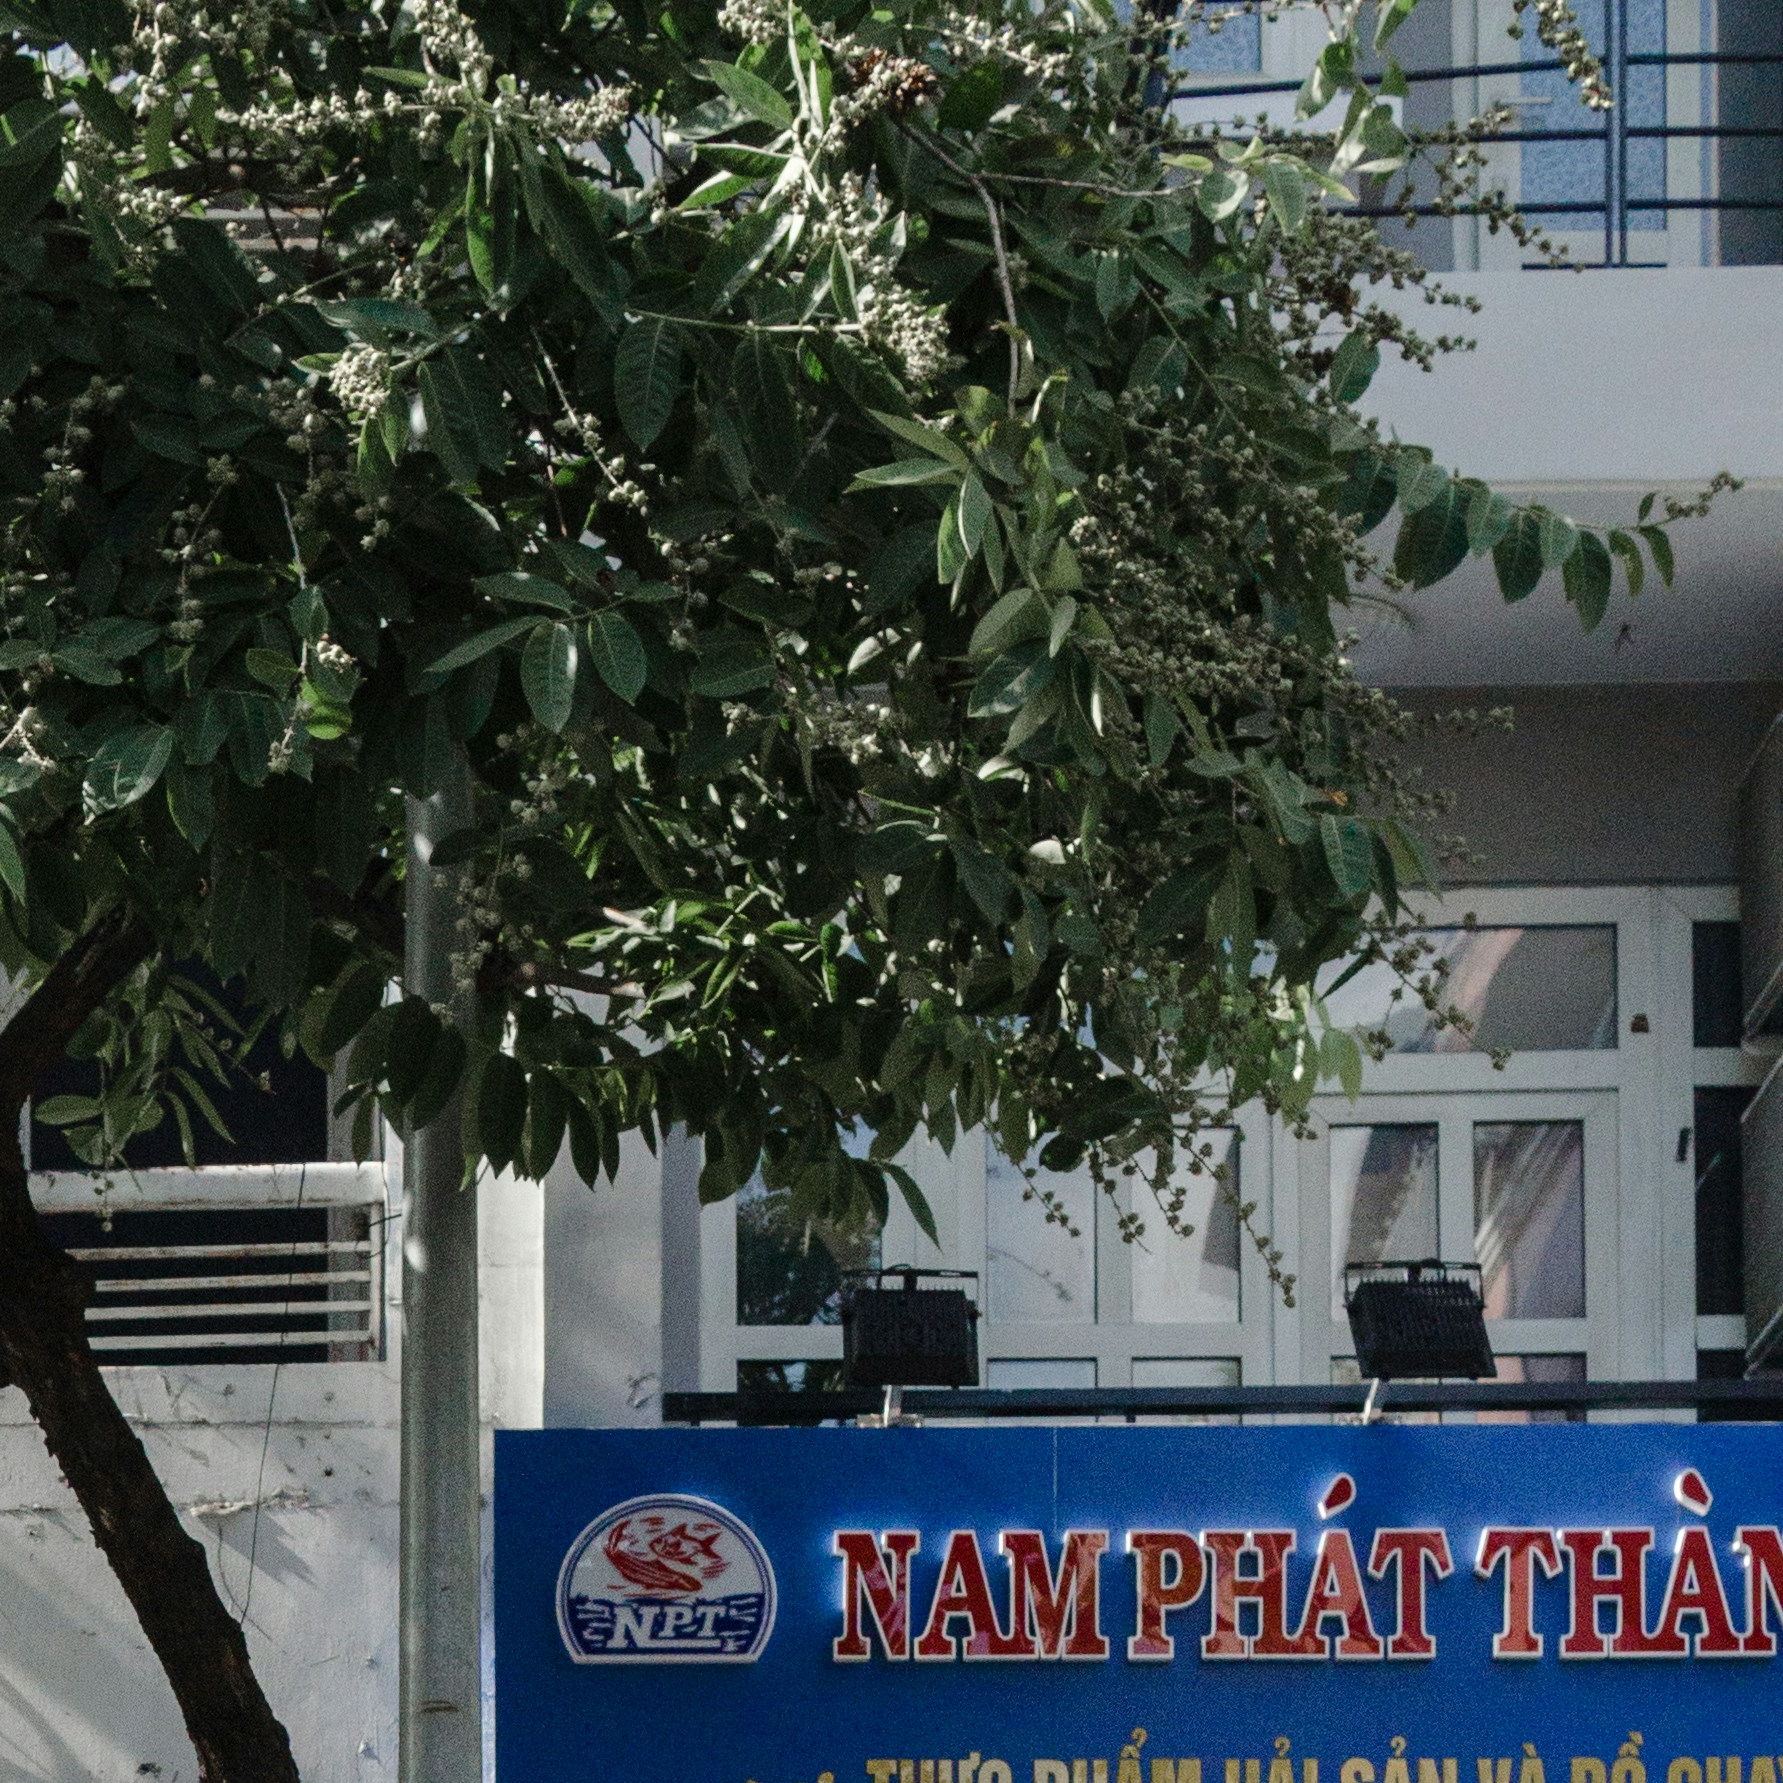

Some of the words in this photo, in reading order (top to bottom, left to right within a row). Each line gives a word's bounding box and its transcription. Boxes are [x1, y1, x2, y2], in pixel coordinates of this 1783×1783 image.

[833, 1529, 1110, 1662] NAM
[1126, 1472, 1454, 1661] PHÁT
[607, 1604, 727, 1649] NPT
